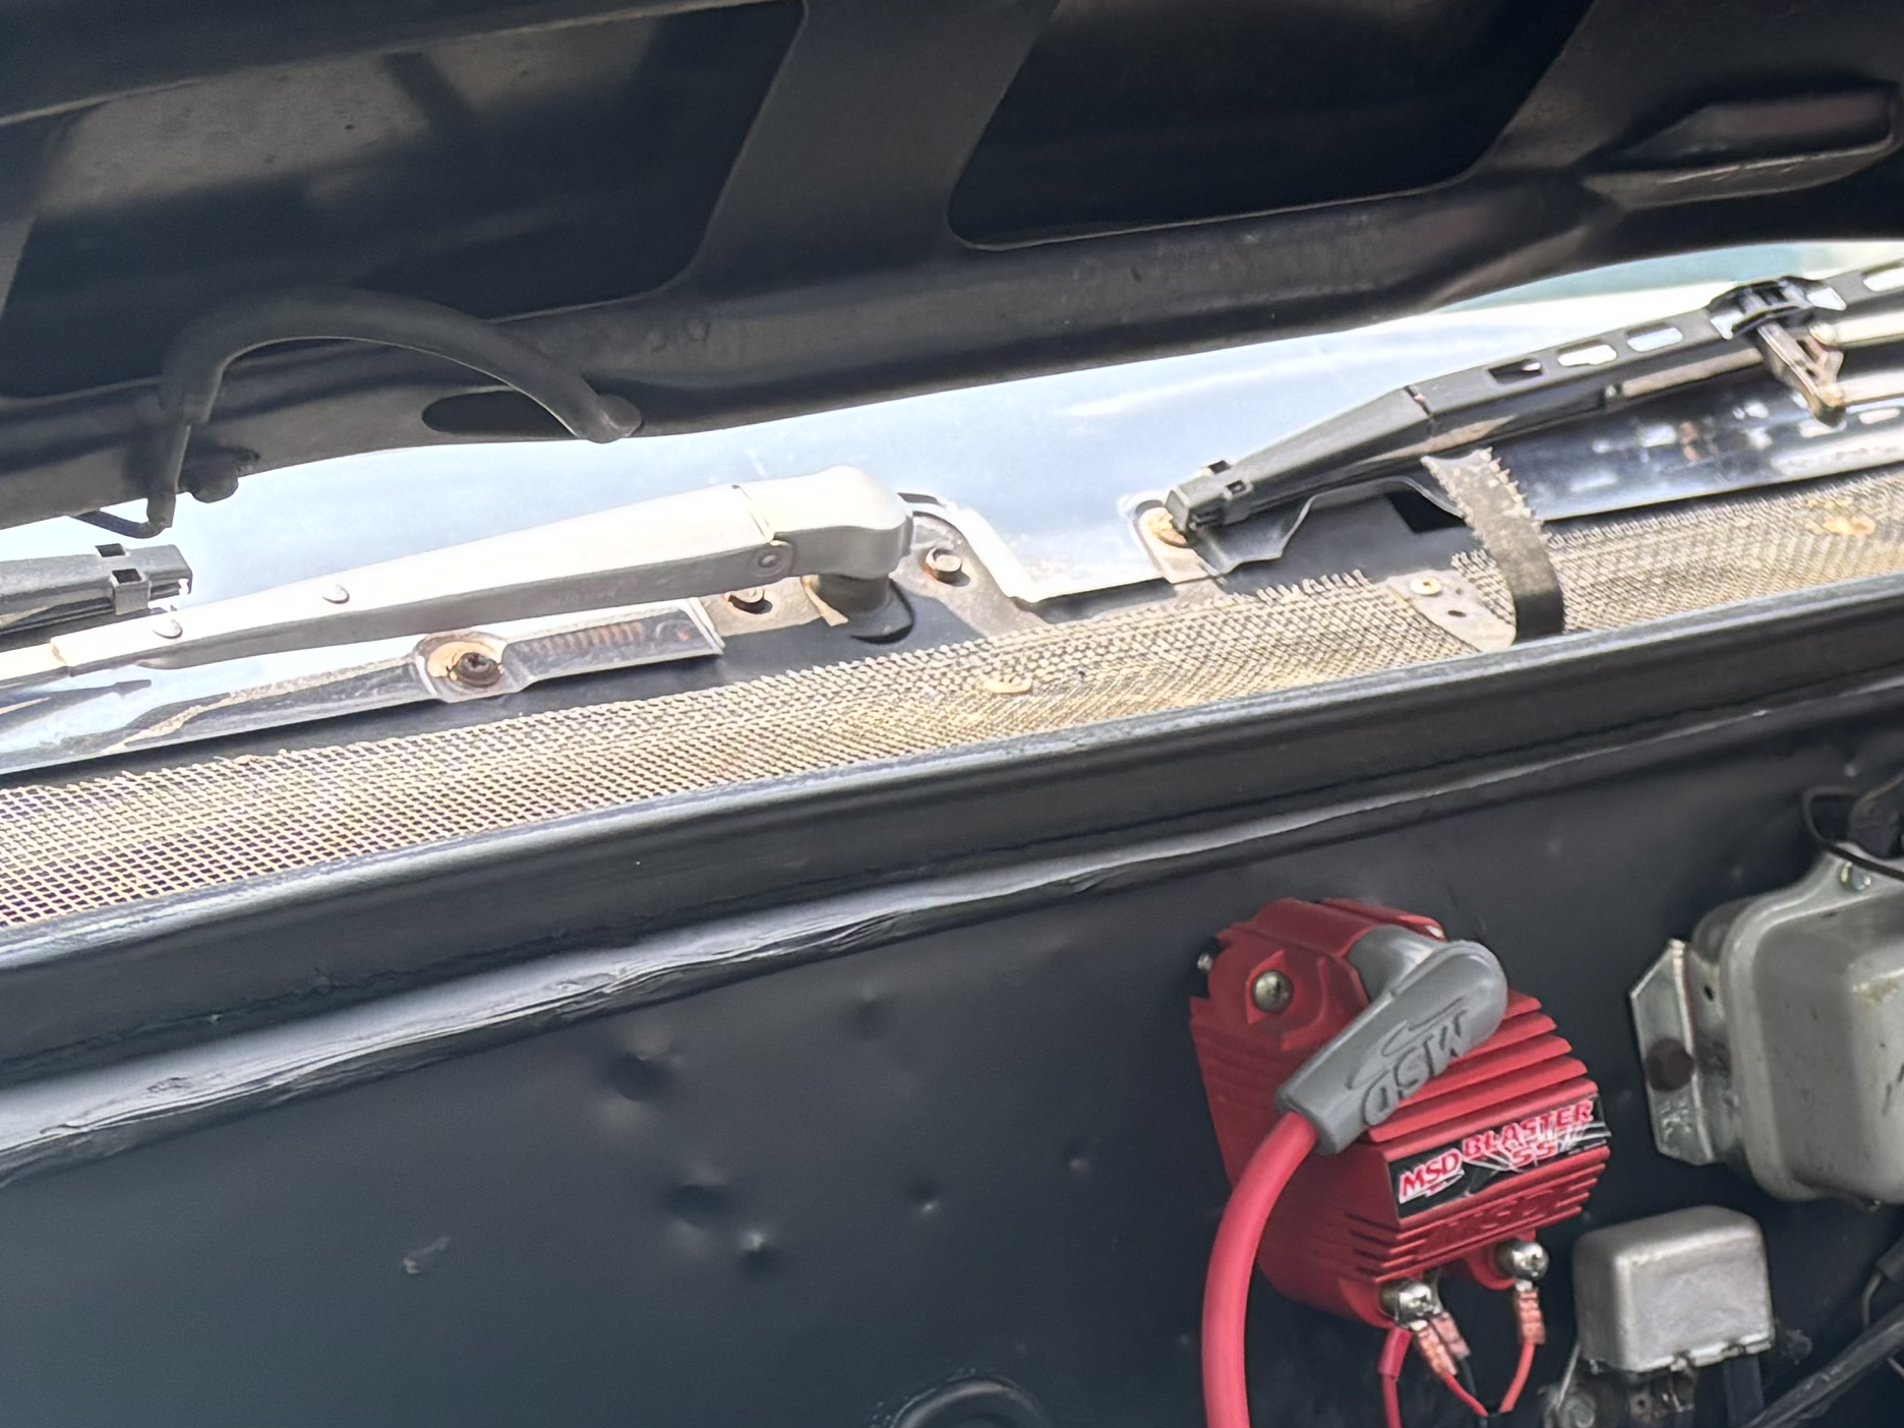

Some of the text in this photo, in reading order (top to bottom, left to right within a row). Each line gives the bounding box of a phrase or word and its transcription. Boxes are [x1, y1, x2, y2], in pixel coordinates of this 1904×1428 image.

[1401, 1101, 1596, 1200] MSD BLASTER
[1510, 1140, 1558, 1168] SS
